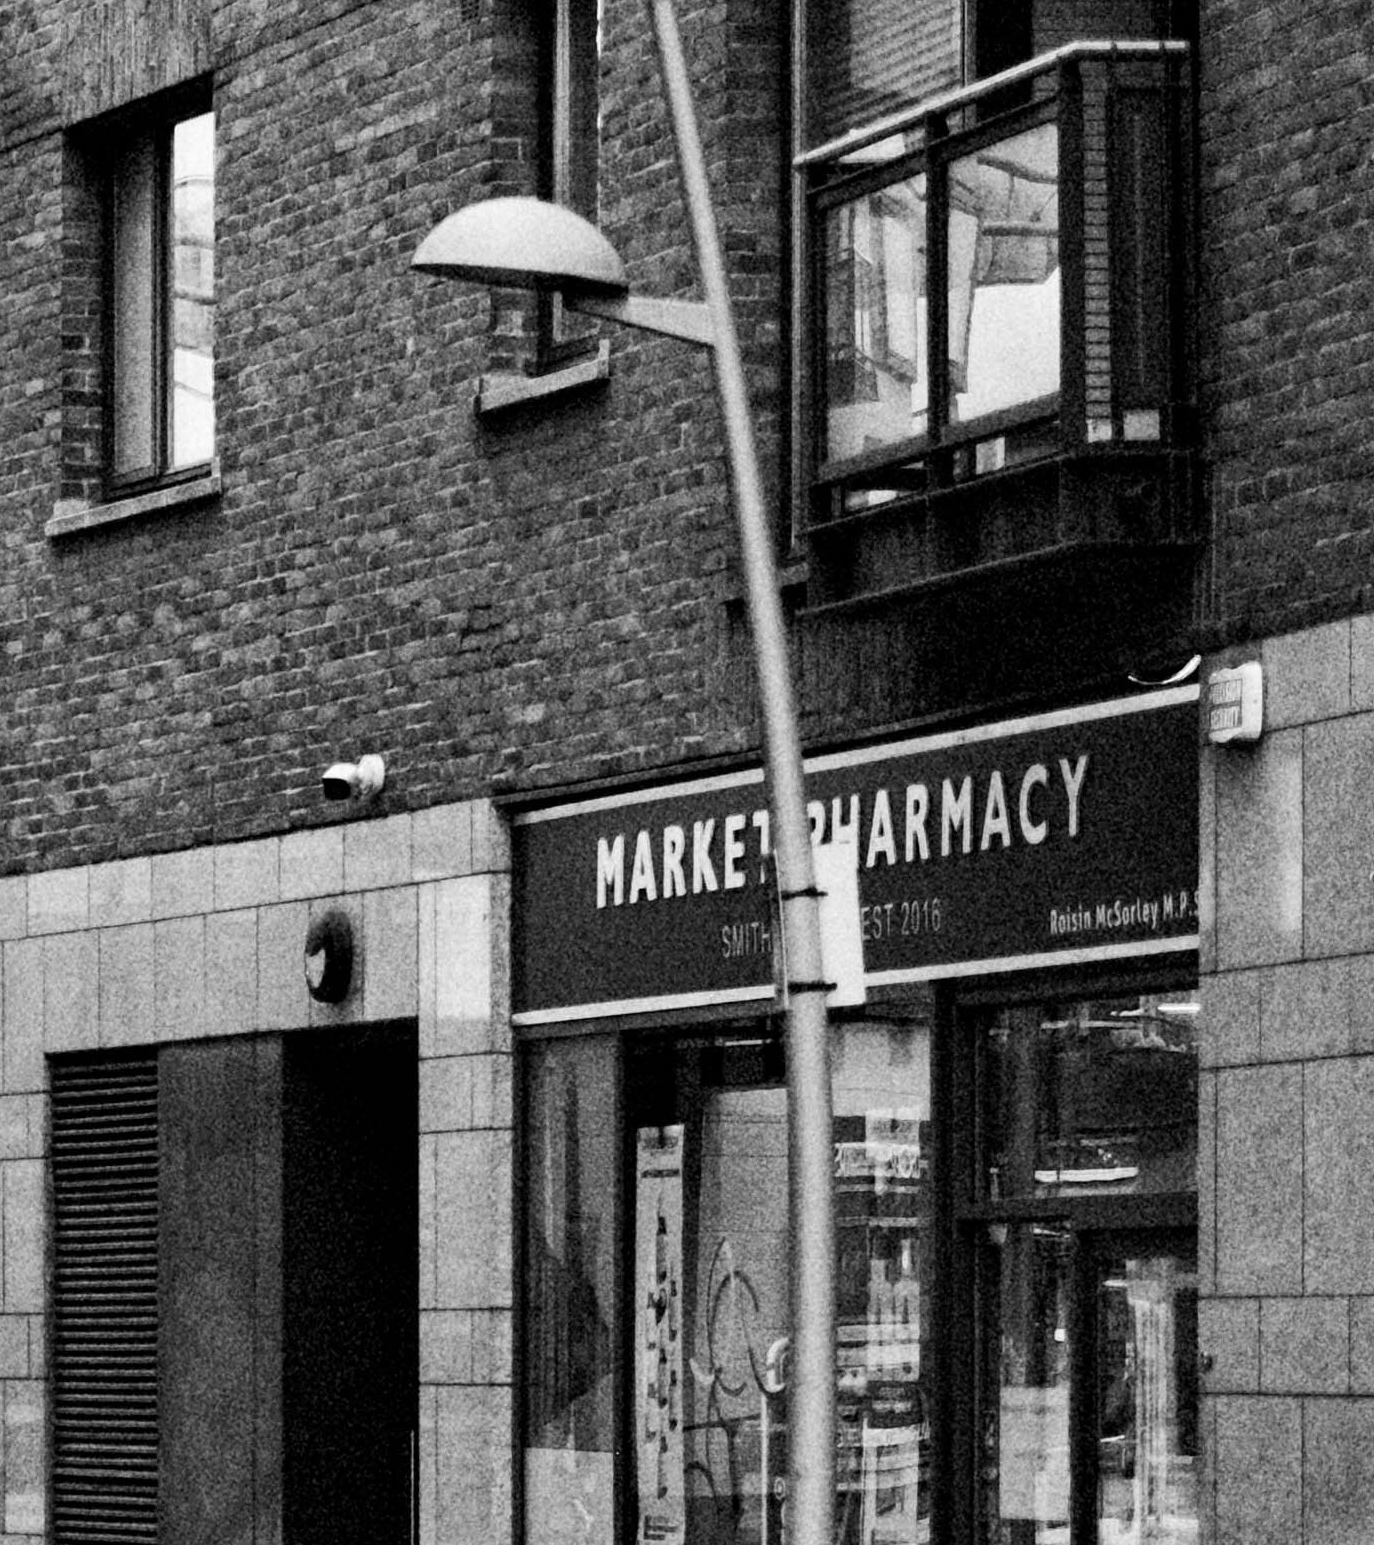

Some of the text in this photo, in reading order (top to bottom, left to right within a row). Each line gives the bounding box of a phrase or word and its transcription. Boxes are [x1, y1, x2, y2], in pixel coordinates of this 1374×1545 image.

[597, 809, 770, 909] MARKET
[722, 897, 941, 958] SMITH EST 2016
[1096, 896, 1158, 930] McSorley
